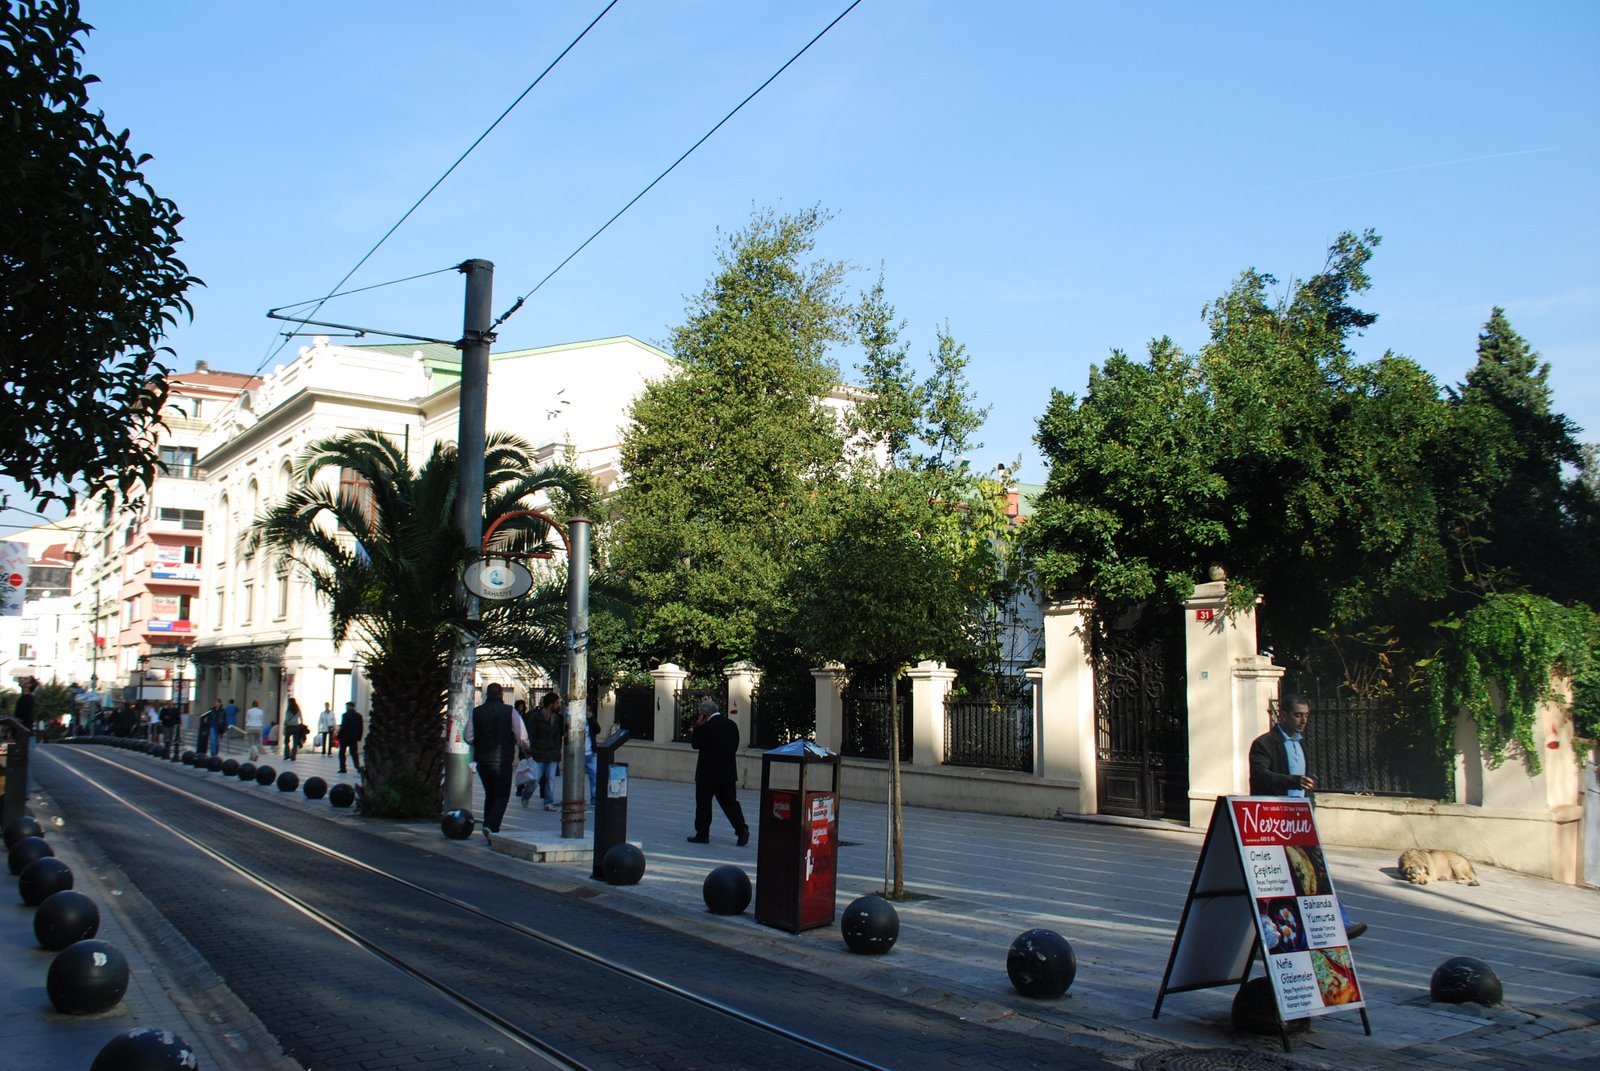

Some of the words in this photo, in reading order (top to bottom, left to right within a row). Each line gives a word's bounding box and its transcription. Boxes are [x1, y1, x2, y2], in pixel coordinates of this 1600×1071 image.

[1200, 611, 1210, 619] 31
[1242, 803, 1312, 840] Nevzemin
[1250, 850, 1271, 861] Omlet
[1253, 864, 1282, 878] Çeşitleri
[1303, 898, 1332, 909] Sahanda
[1306, 913, 1336, 923] Yumurta
[1275, 957, 1293, 969] Nefis
[1280, 971, 1313, 984] Gözlemeler
